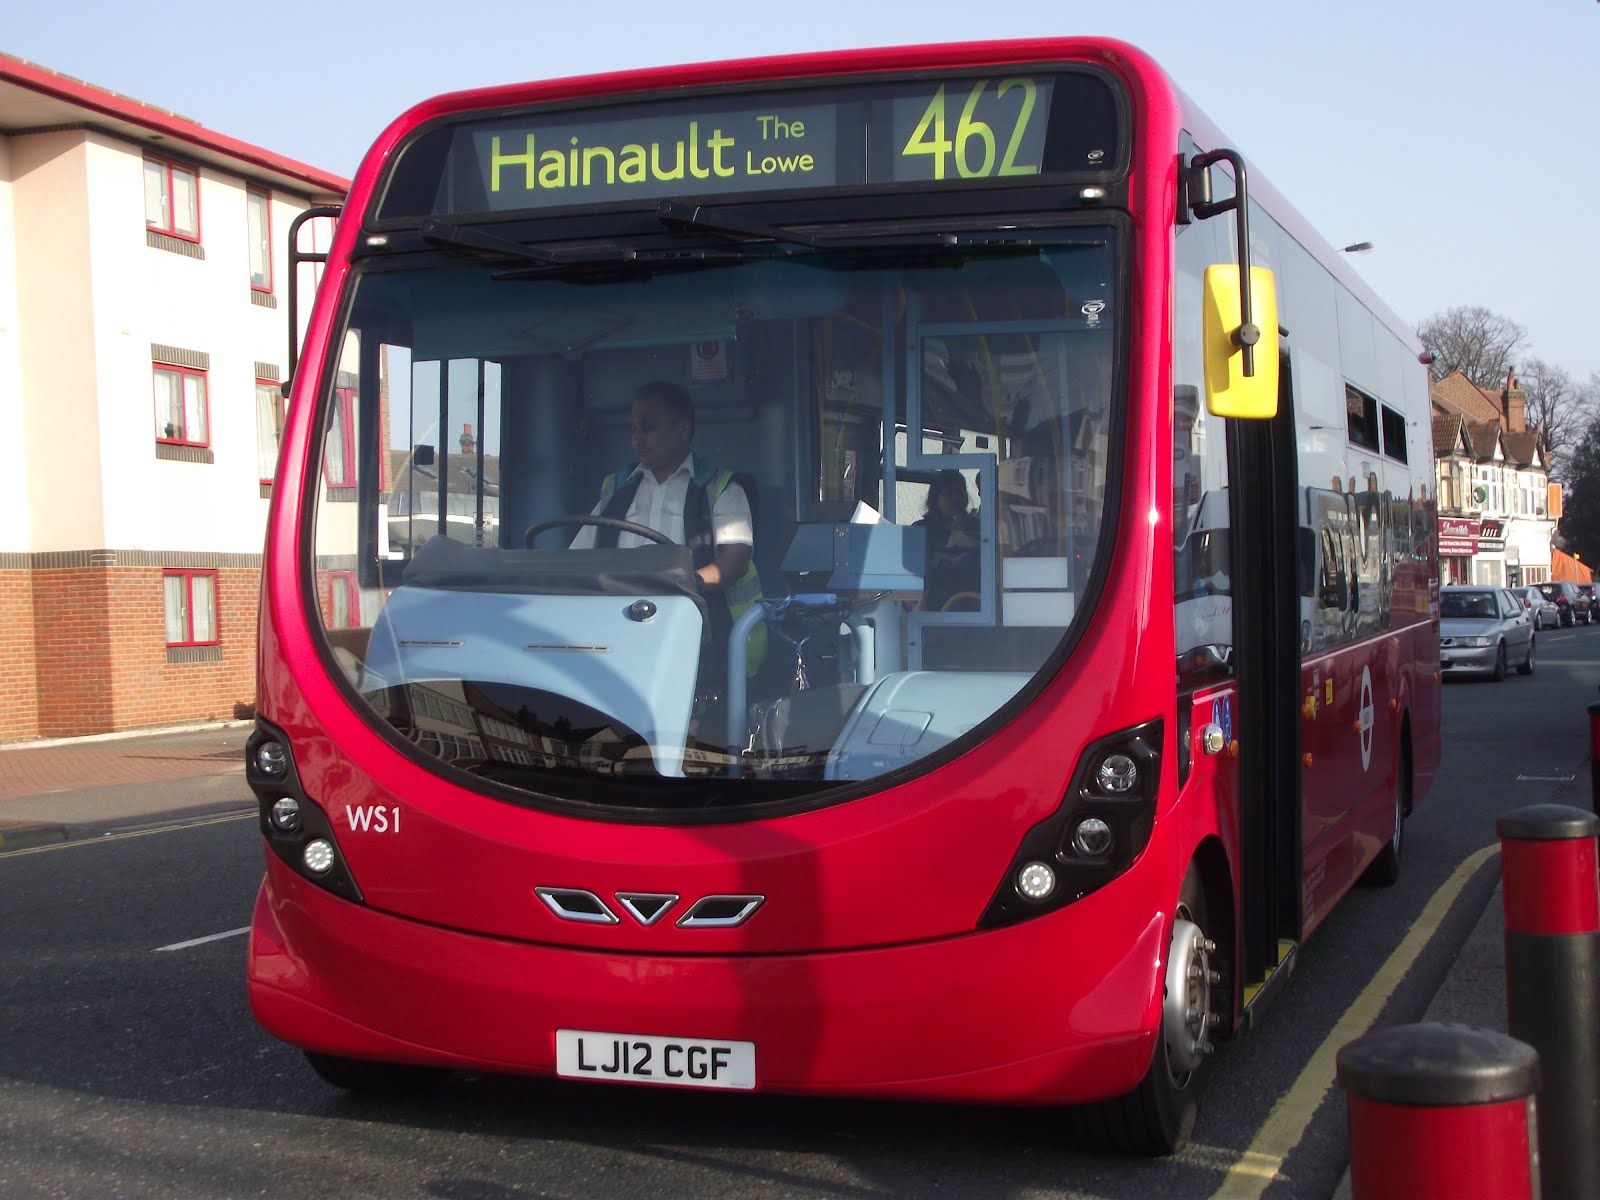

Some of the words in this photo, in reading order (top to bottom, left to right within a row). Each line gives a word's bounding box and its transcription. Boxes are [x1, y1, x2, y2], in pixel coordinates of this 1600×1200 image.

[756, 115, 805, 140] The
[902, 77, 1038, 181] 462
[491, 121, 735, 192] Hainault
[747, 151, 815, 175] Lowe
[345, 804, 400, 833] WS1
[577, 1037, 653, 1076] LJ12
[664, 1044, 732, 1081] CGF
